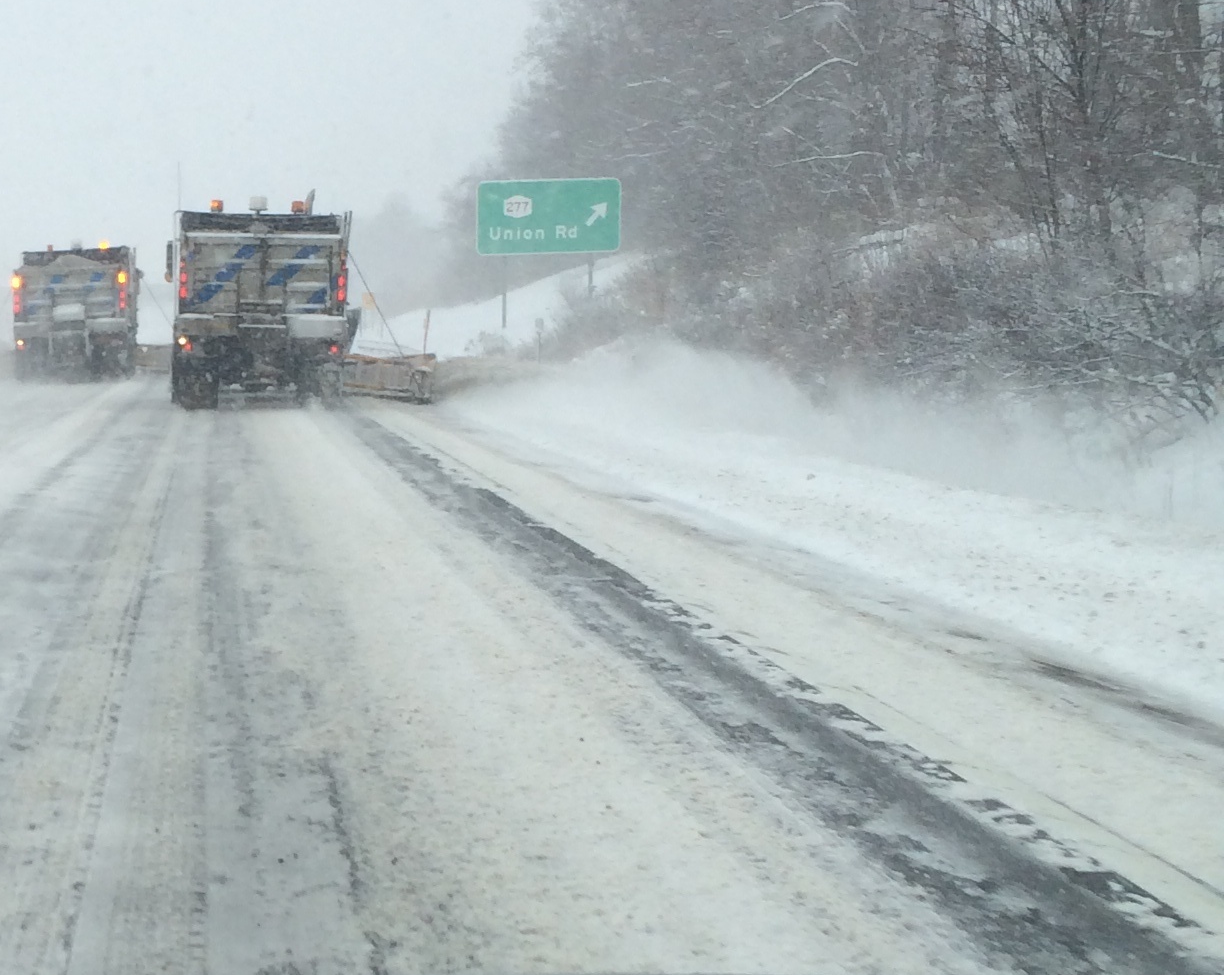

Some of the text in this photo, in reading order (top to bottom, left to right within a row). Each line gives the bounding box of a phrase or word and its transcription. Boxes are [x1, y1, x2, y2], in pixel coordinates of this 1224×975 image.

[506, 201, 529, 213] 277
[489, 225, 578, 241] Union Rd
